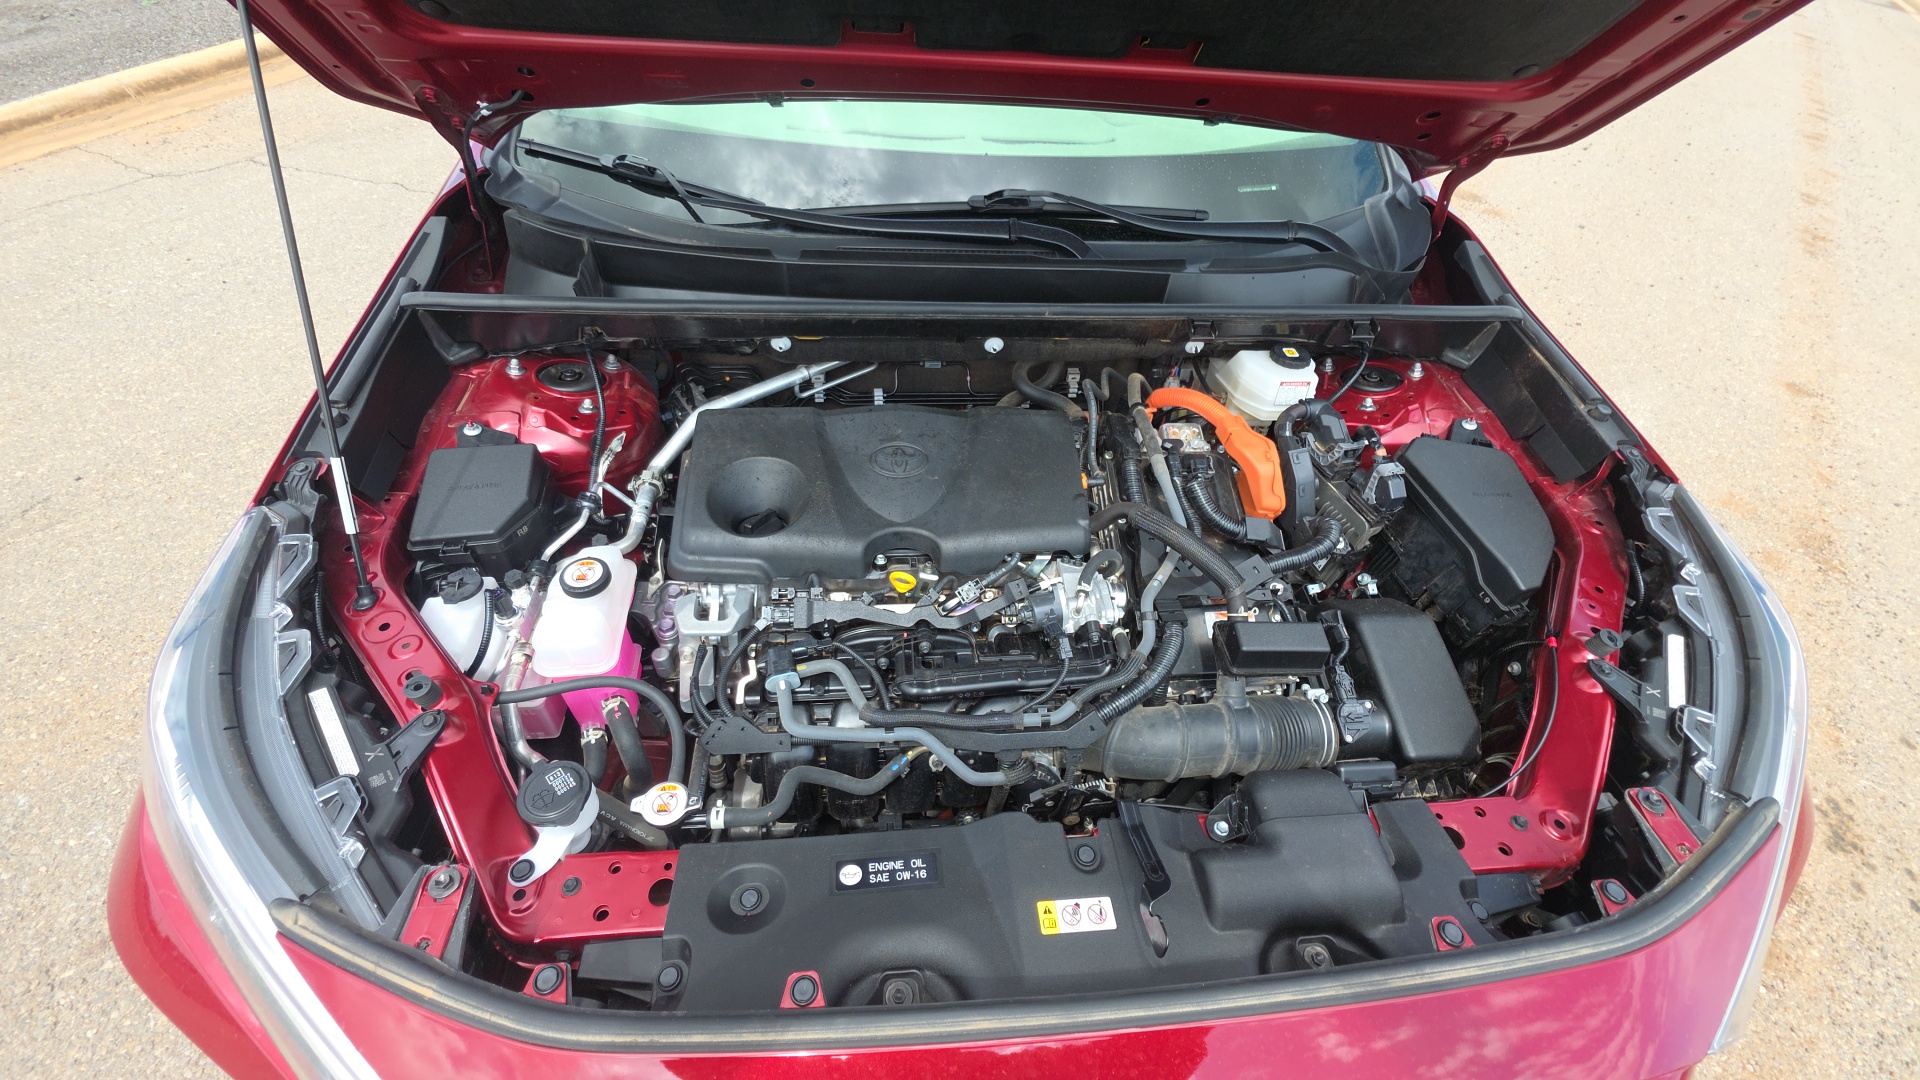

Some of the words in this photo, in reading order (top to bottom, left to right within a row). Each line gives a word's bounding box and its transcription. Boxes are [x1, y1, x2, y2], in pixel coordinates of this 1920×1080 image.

[619, 820, 647, 838] YOKOHAMA
[868, 860, 905, 872] ENGINE
[910, 858, 927, 868] OIL
[869, 872, 890, 883] SAE
